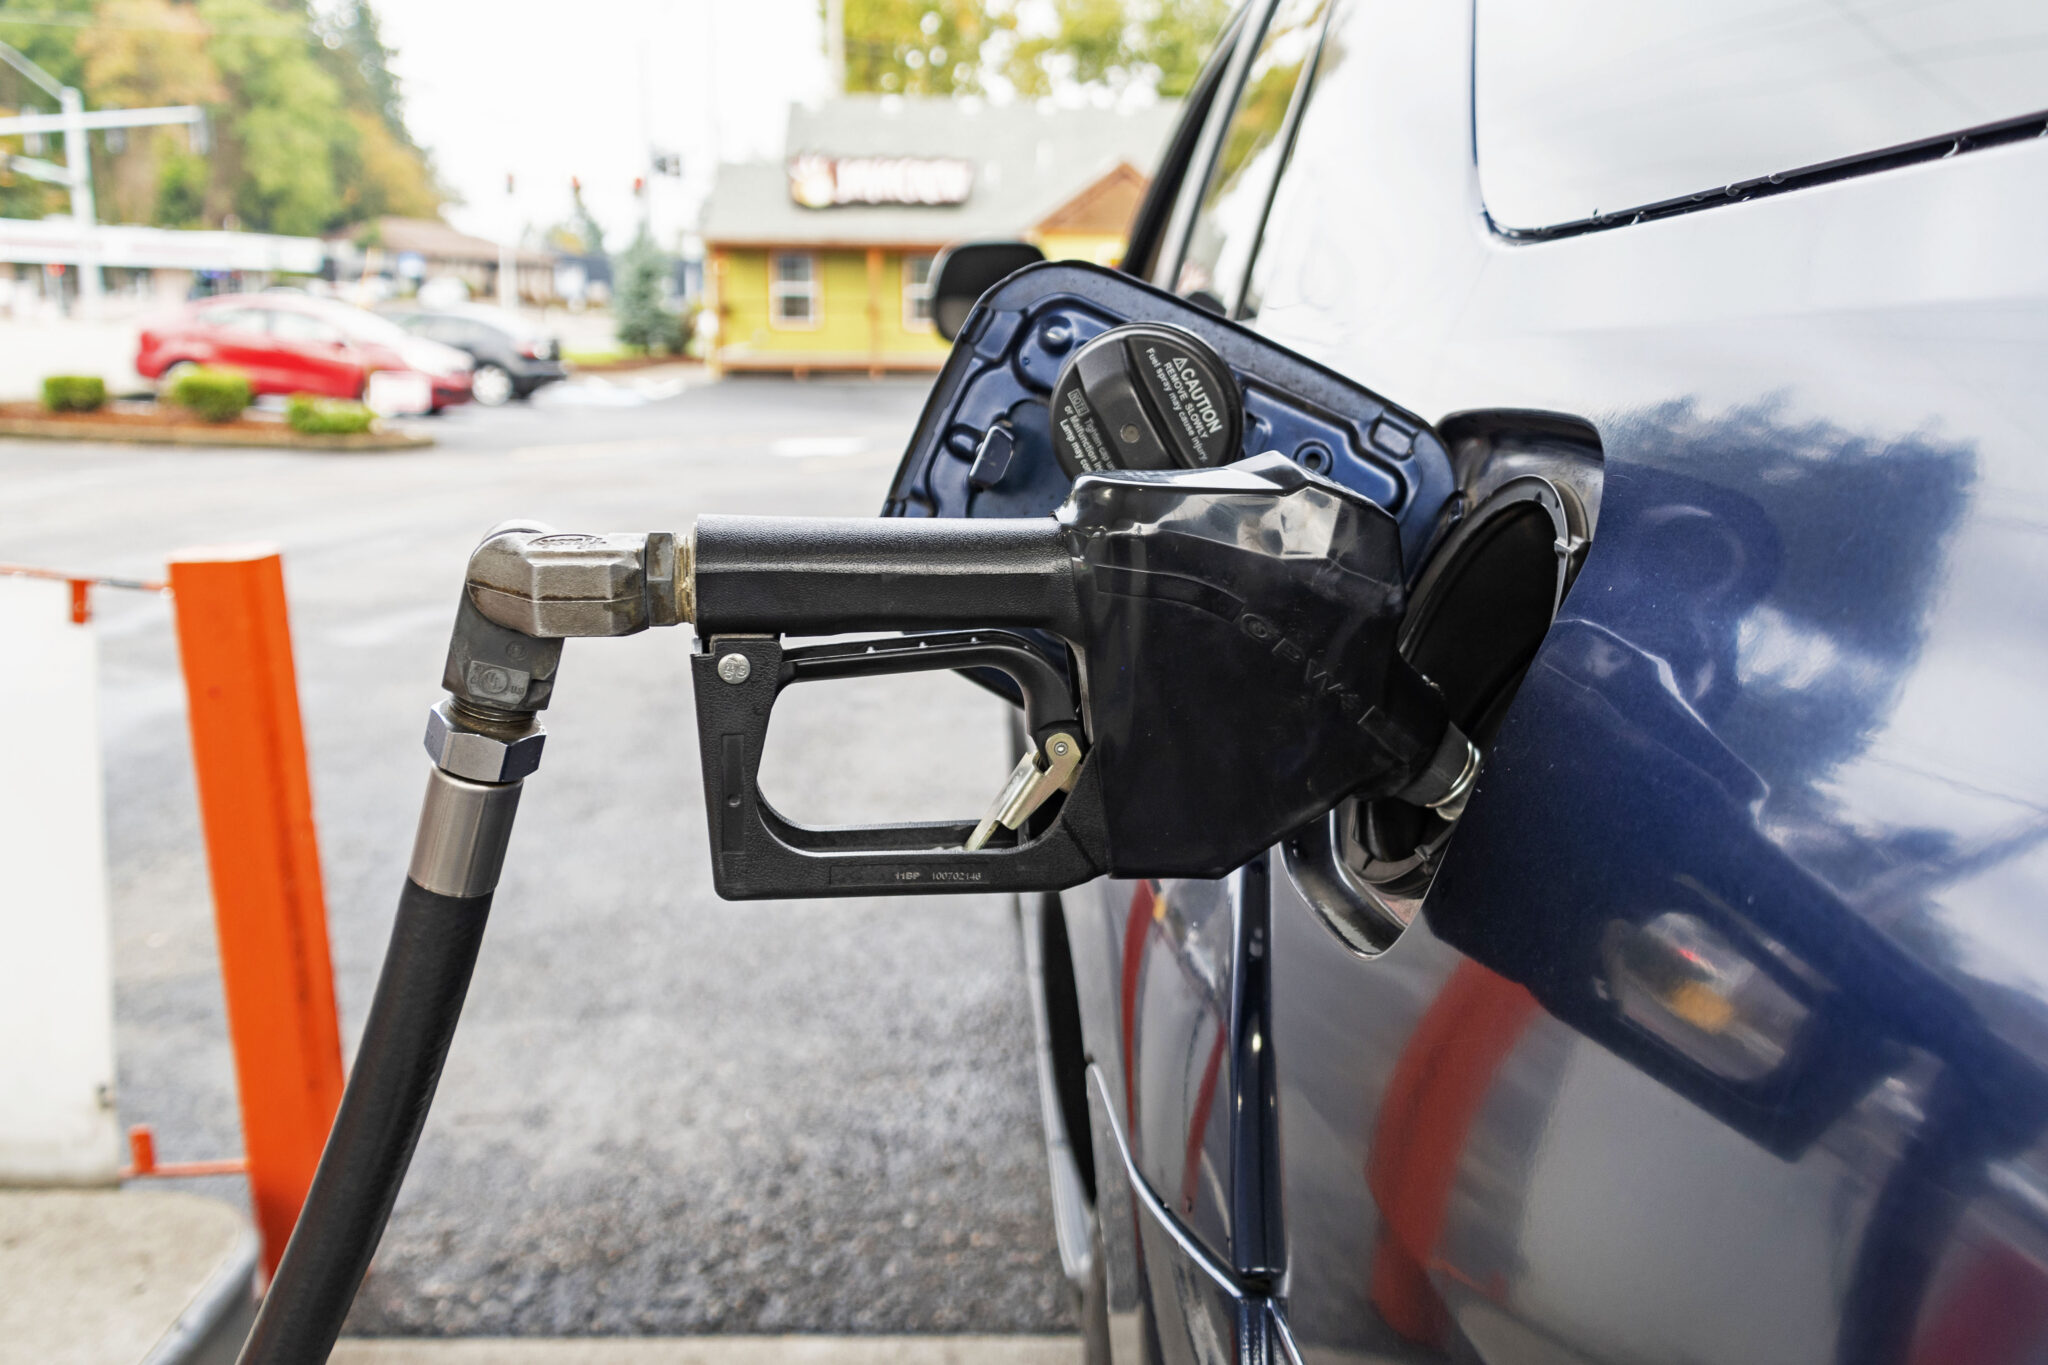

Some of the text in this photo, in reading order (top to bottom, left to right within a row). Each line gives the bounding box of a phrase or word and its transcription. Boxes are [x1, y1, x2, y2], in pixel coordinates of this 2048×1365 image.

[1068, 390, 1088, 415] NOTE
[1084, 417, 1102, 447] Tighten
[1098, 446, 1110, 461] cap
[1145, 347, 1162, 368] Fuel
[1155, 367, 1172, 392] spray
[1168, 392, 1182, 411] may
[1178, 411, 1195, 436] cause
[1163, 361, 1209, 439] REMOVE SLOWLY
[1181, 368, 1223, 434] CAUTION
[1060, 418, 1076, 442] Lamp
[1071, 441, 1084, 459] may
[1064, 405, 1098, 462] or Malfunction
